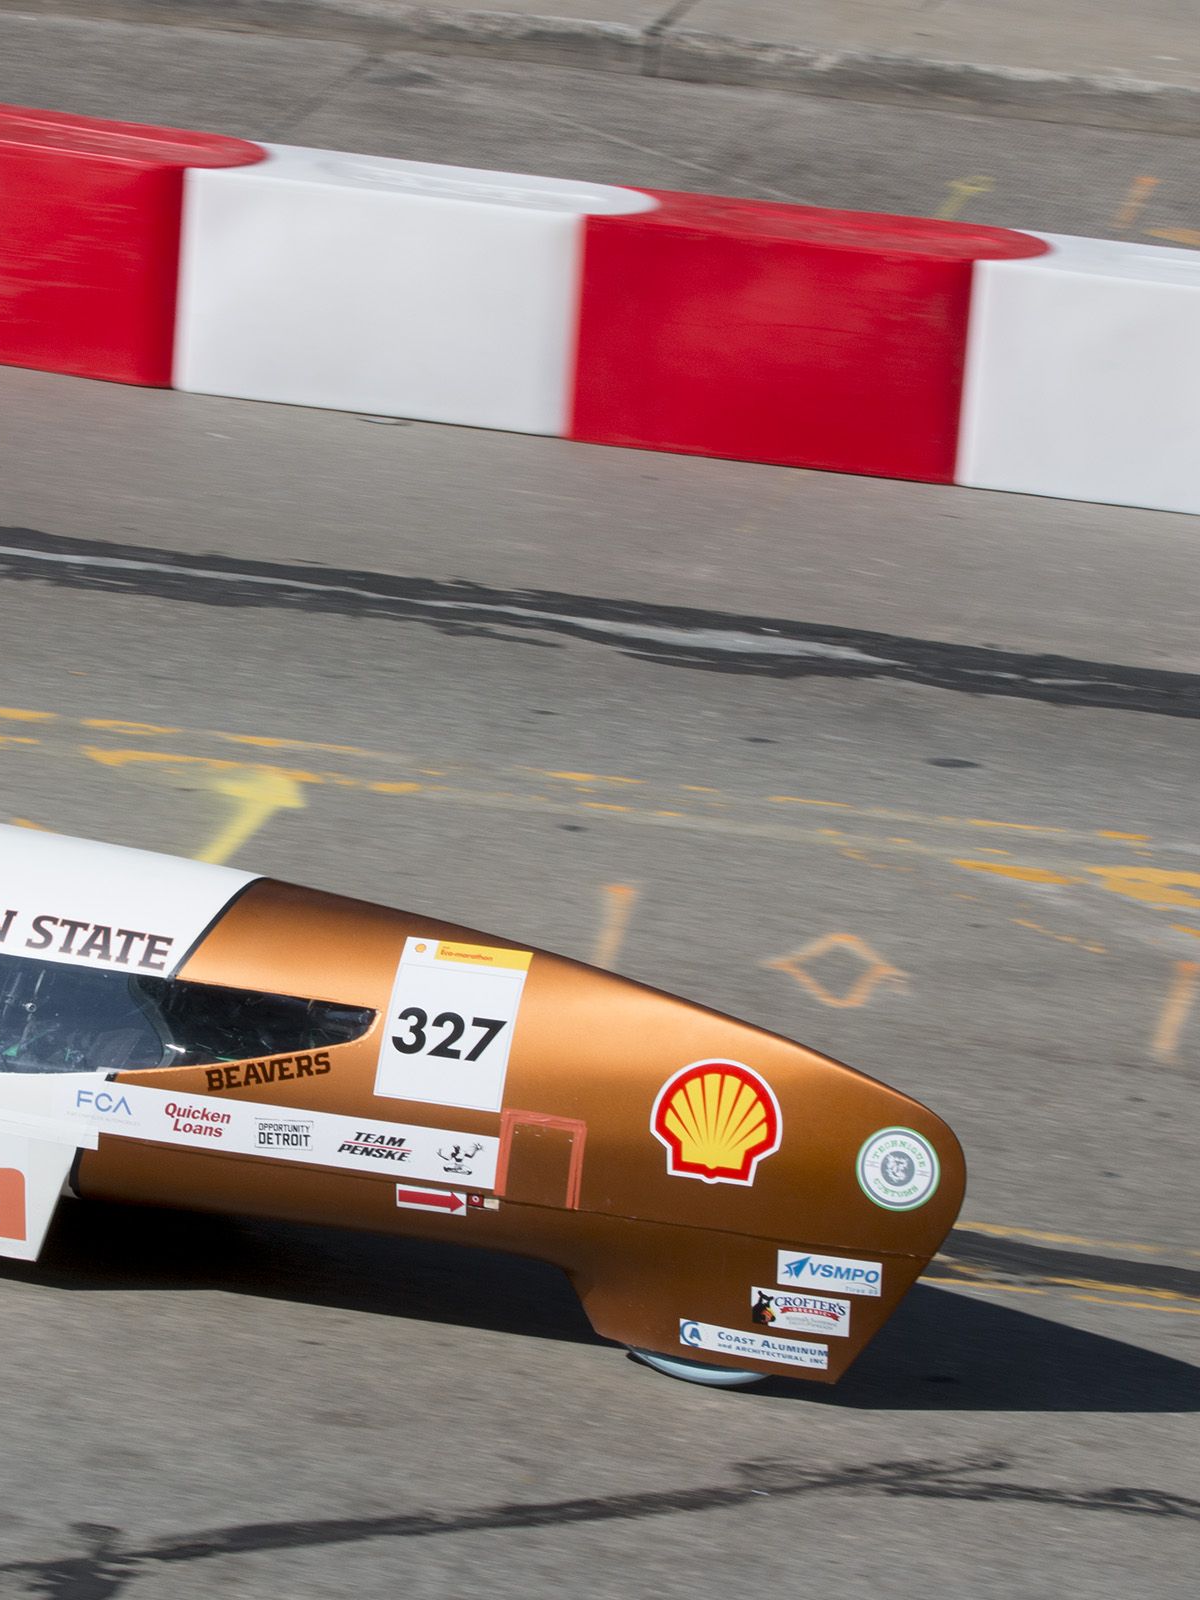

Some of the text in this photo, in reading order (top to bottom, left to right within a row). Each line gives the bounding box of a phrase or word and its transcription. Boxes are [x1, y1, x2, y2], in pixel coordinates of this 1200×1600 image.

[25, 914, 174, 971] STATE
[391, 1006, 508, 1062] 327
[205, 1052, 331, 1092] BEAVERS
[76, 1089, 132, 1116] FCA
[164, 1102, 232, 1124] Quicken
[172, 1118, 224, 1138] Loans
[258, 1123, 310, 1134] OPPORTUNITY
[258, 1132, 311, 1147] DETROIT
[354, 1131, 406, 1147] TEAM
[337, 1143, 411, 1162] PENSKE
[809, 1262, 880, 1284] VSMPO
[774, 1296, 847, 1316] CROFTER'S
